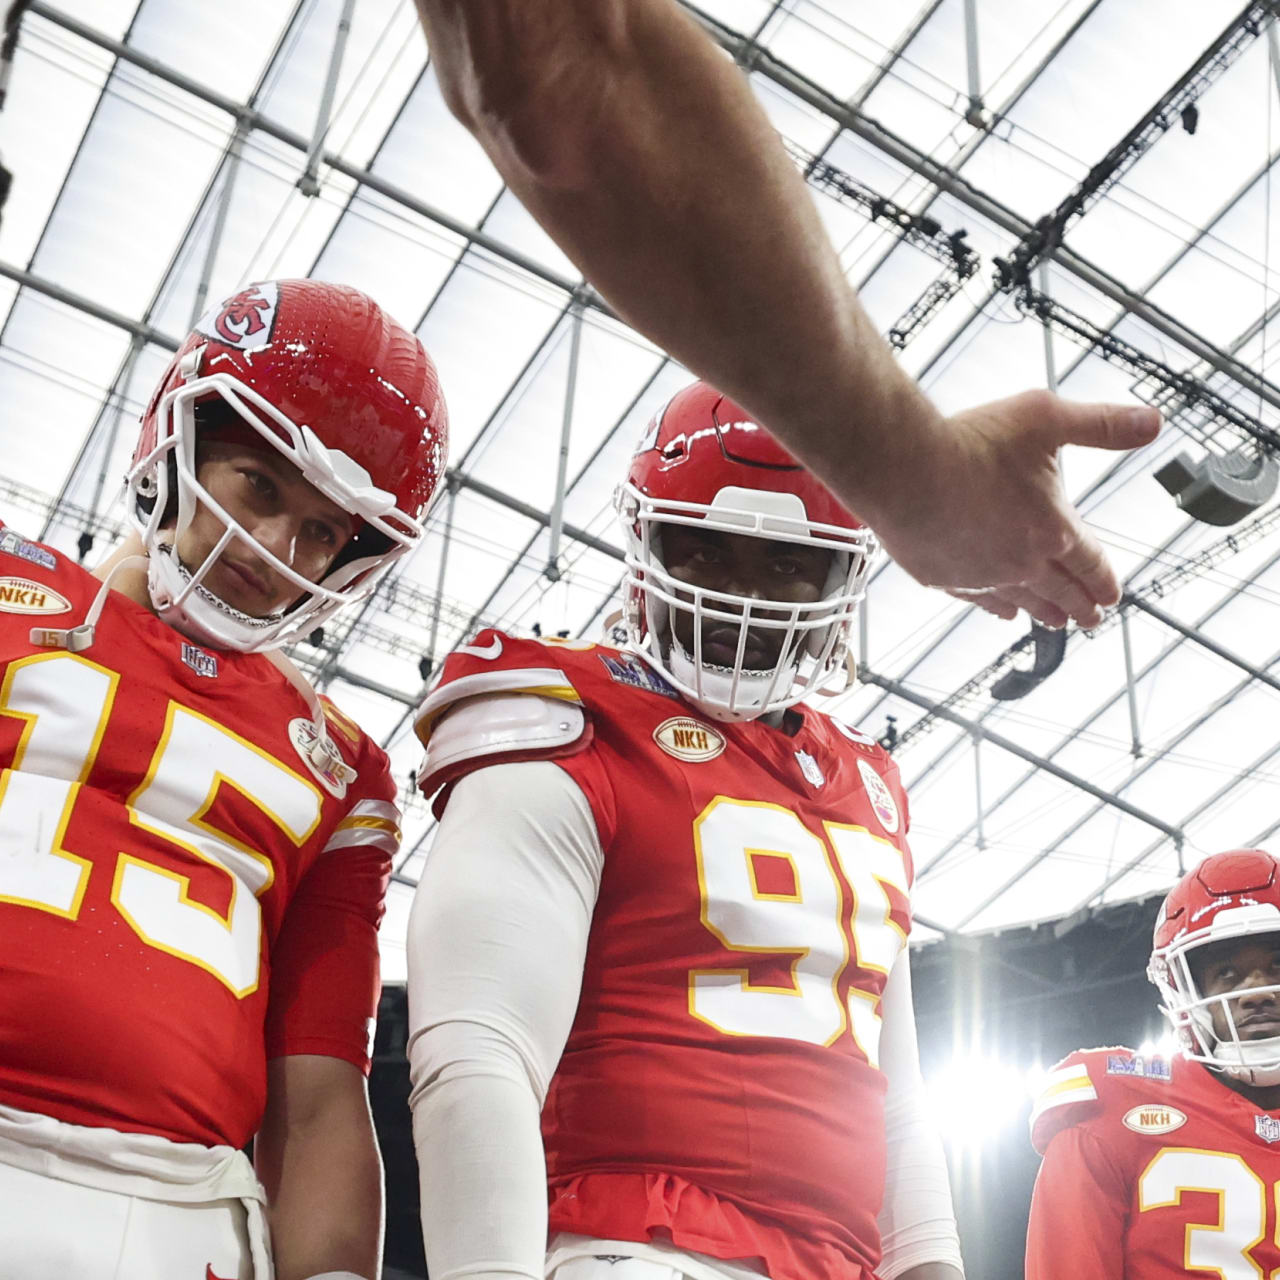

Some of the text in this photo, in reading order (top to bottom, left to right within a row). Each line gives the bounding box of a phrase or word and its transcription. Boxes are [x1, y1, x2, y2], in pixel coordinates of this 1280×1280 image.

[40, 631, 59, 647] 15
[672, 729, 710, 751] NKH
[688, 795, 909, 1068] 95
[1139, 1109, 1171, 1126] NKH
